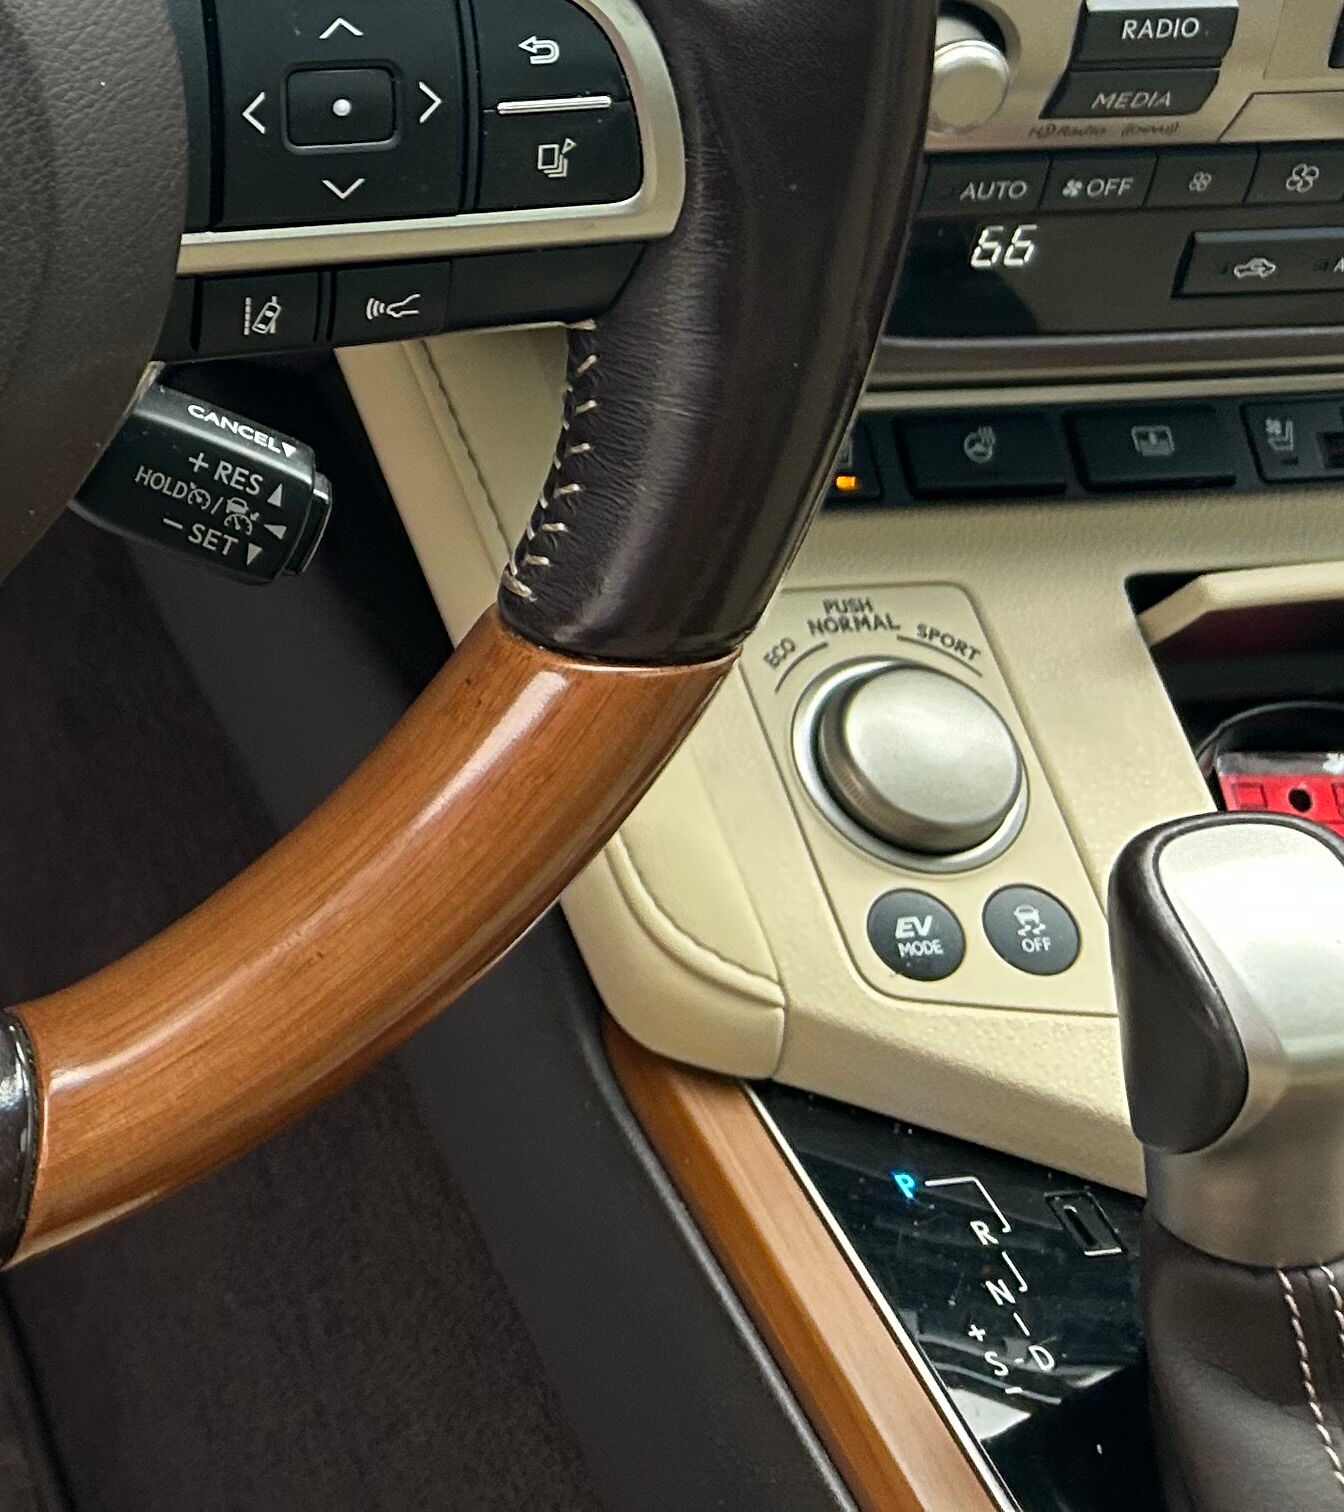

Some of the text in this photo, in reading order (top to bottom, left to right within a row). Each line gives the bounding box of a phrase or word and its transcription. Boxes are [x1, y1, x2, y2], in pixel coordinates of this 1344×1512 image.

[1120, 17, 1201, 41] RADIO
[1090, 90, 1172, 110] MEDIA
[959, 181, 1028, 201] AUTO
[1086, 178, 1134, 198] OFF
[969, 223, 1039, 271] 66
[187, 404, 281, 454] CANCEL
[135, 465, 188, 499] HOLD
[214, 460, 264, 496] RES
[188, 523, 239, 556] SET
[821, 597, 874, 617] PUSH
[806, 610, 901, 638] NORMAL
[762, 637, 797, 671] ECO
[915, 622, 982, 663] SPORT
[894, 916, 934, 938] EV
[898, 937, 944, 958] MODE
[1020, 936, 1053, 955] OFF
[892, 1171, 916, 1199] P
[970, 1219, 999, 1246] R
[985, 1279, 1016, 1307] N
[984, 1351, 1009, 1377] S
[1028, 1345, 1056, 1372] D
